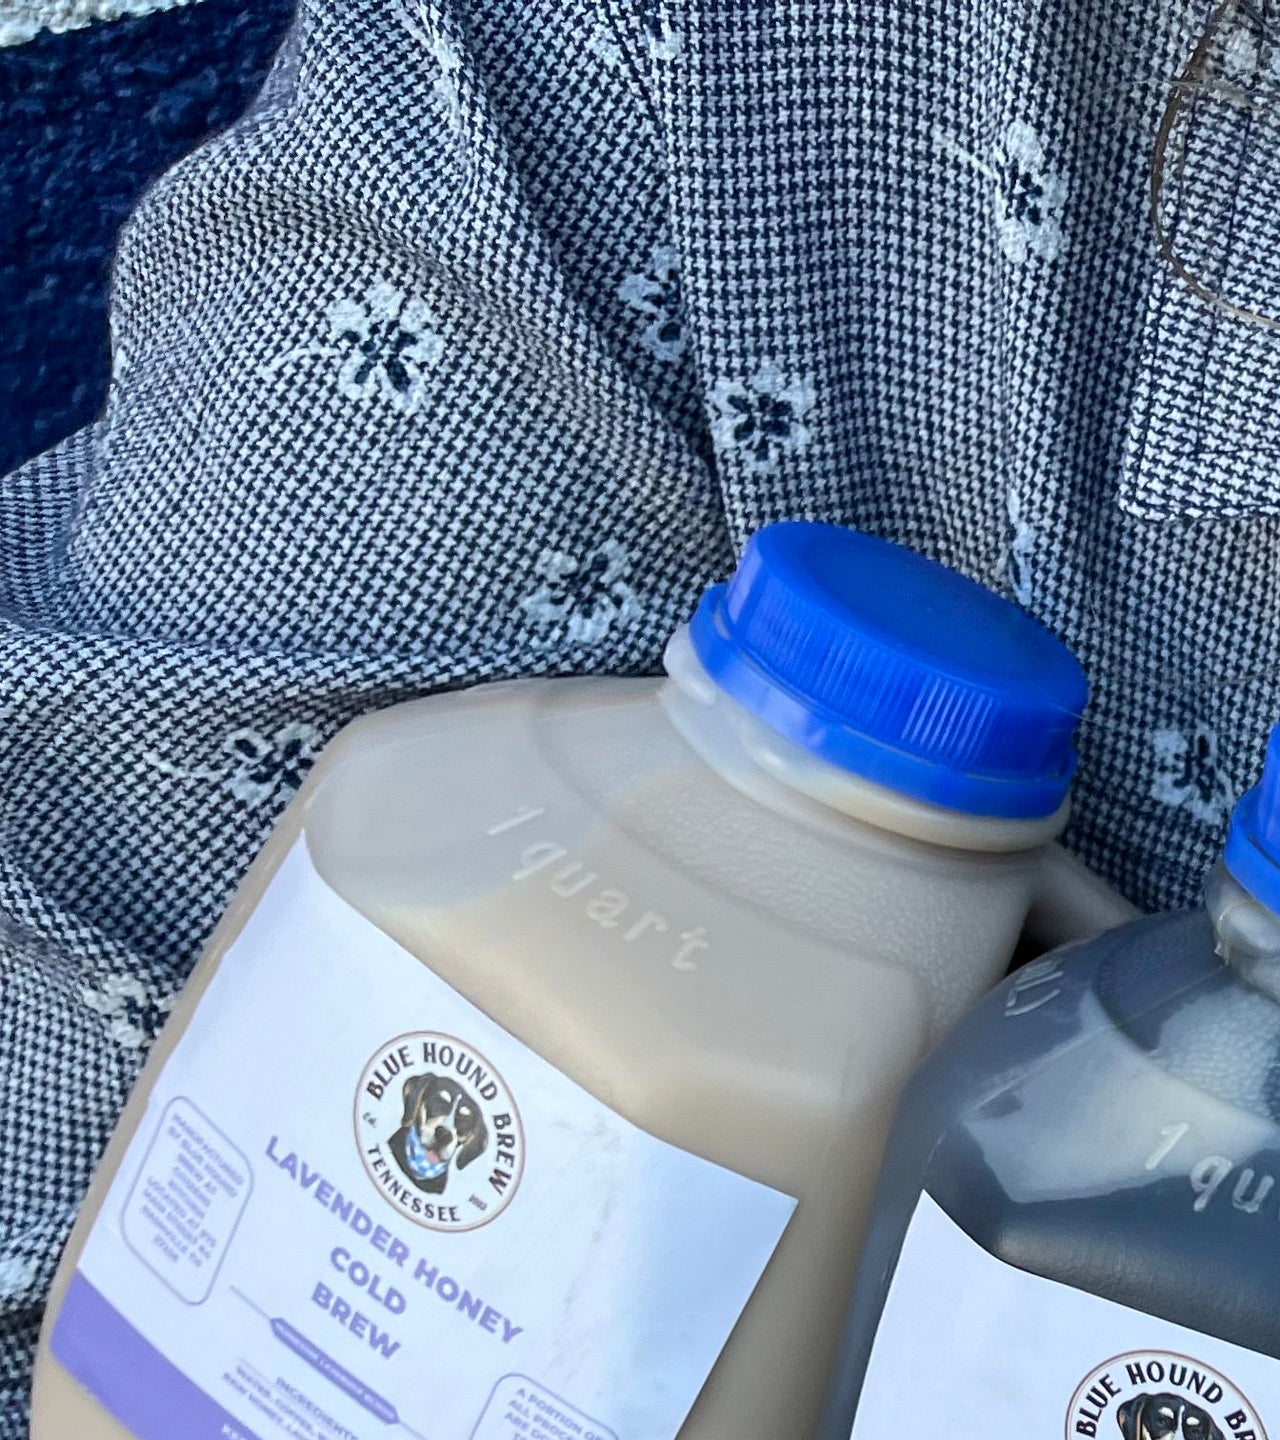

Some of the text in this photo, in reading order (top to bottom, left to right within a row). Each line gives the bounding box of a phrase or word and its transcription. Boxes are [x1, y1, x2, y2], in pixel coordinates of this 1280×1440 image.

[487, 805, 709, 971] 1 quart
[366, 1042, 515, 1197] BLUE HOUND BREW
[1144, 1122, 1189, 1170] 1
[366, 1143, 460, 1221] TENNESSEE
[264, 1135, 409, 1267] LAVENDER
[413, 1258, 523, 1343] HONEY
[330, 1246, 406, 1314] COLD
[310, 1281, 400, 1359] BREW
[1075, 1374, 1122, 1439] BLUE
[1125, 1360, 1223, 1403] HOUND
